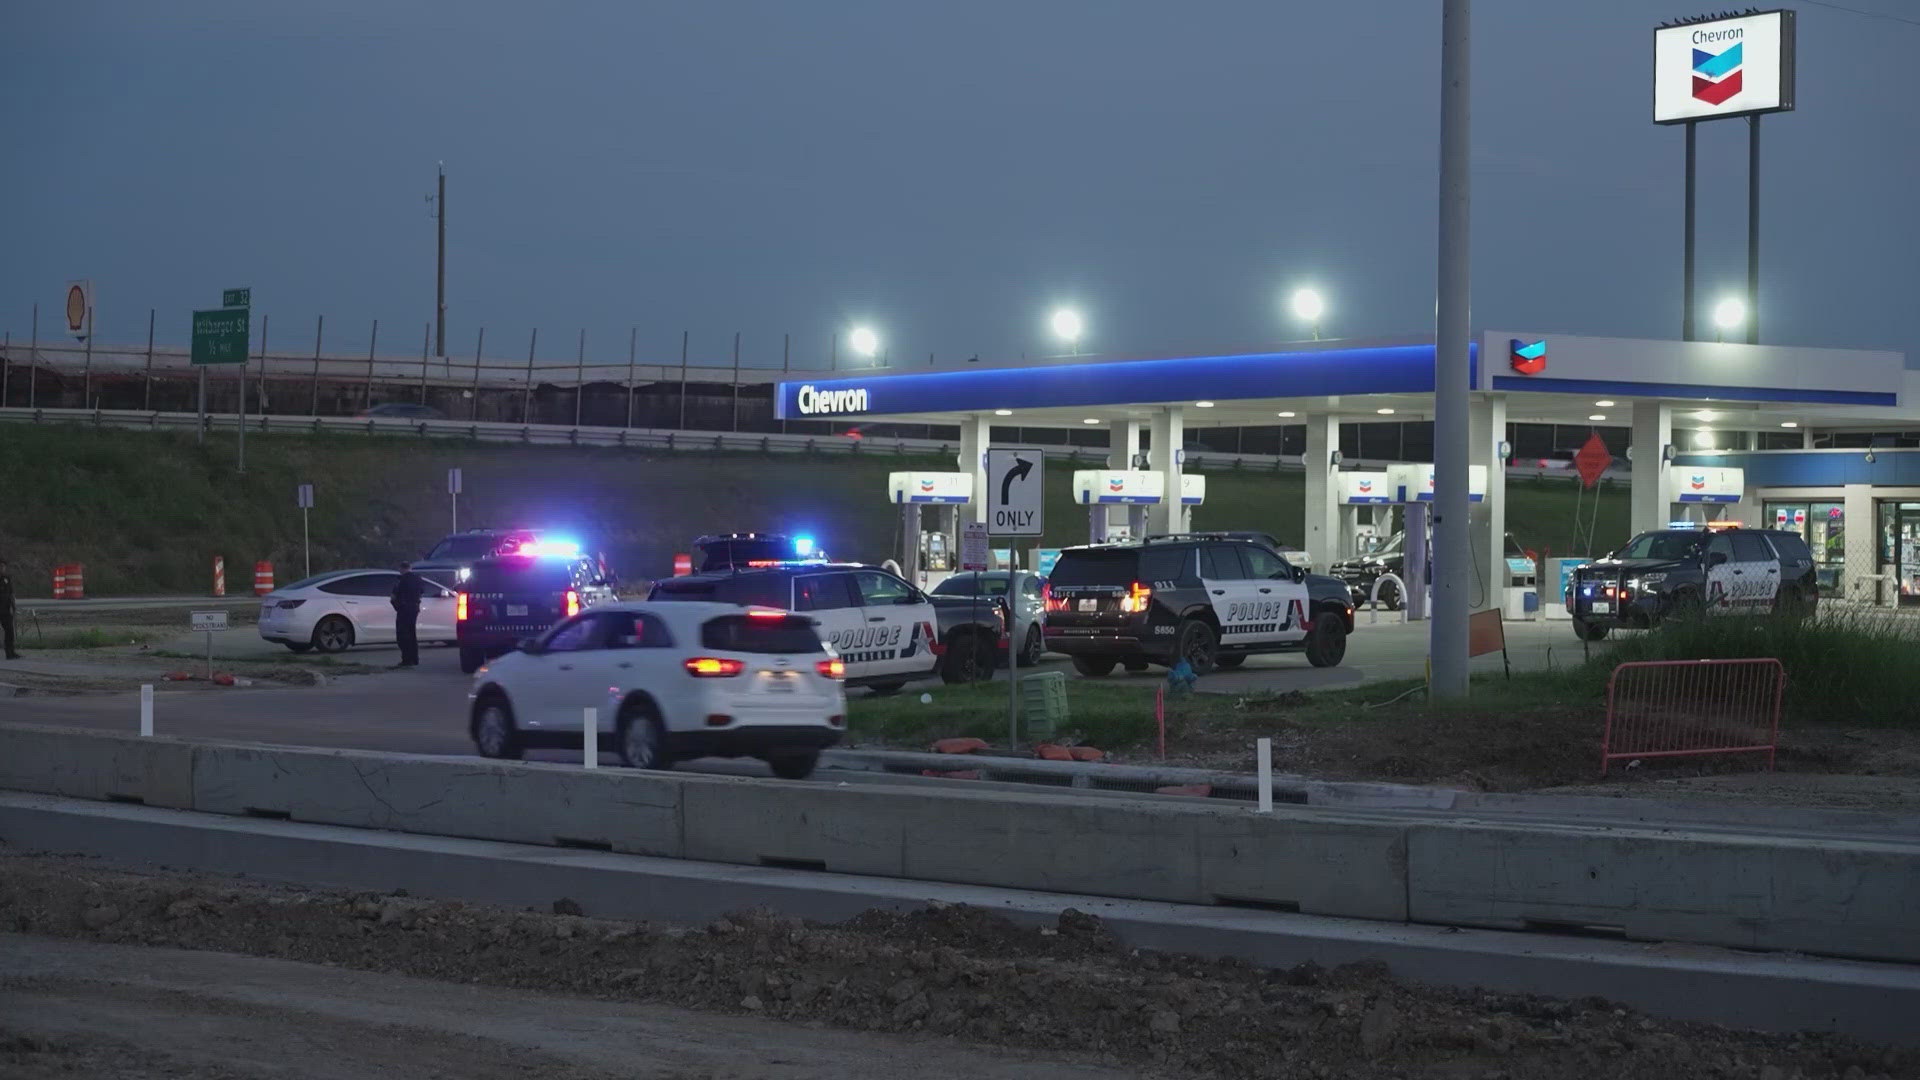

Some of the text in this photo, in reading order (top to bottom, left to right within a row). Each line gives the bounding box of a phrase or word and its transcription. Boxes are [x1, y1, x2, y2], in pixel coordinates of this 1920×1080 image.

[1692, 27, 1743, 44] Chevron
[240, 291, 249, 304] 32
[798, 384, 867, 414] Chevron
[996, 511, 1034, 527] ONLY
[1154, 581, 1175, 589] 911
[1227, 602, 1281, 621] POLICE
[828, 625, 901, 650] POLICE
